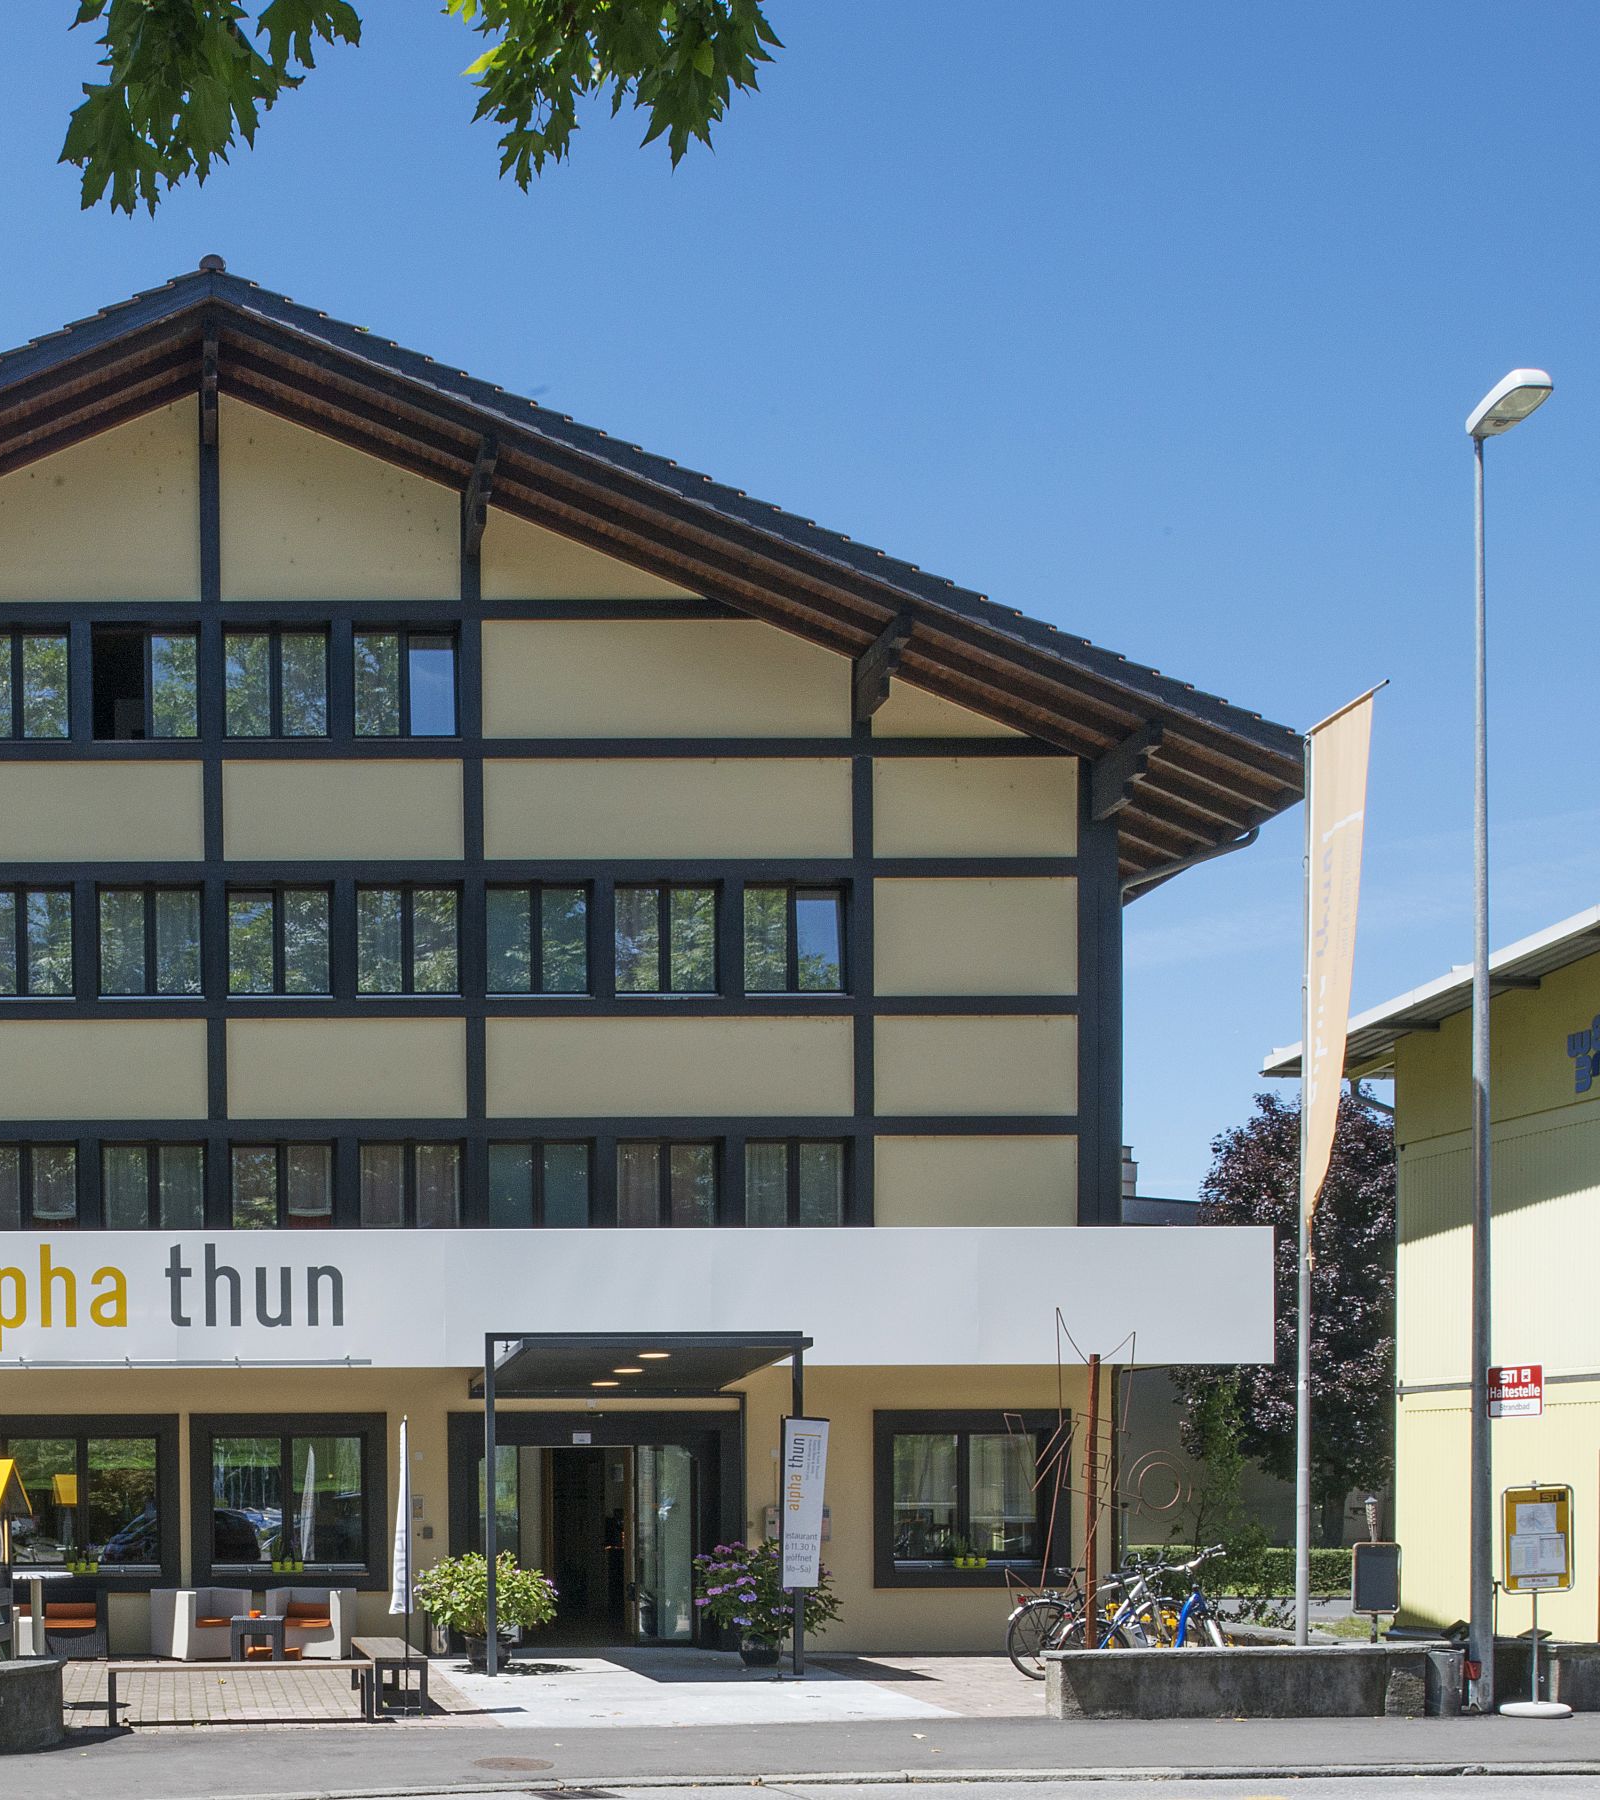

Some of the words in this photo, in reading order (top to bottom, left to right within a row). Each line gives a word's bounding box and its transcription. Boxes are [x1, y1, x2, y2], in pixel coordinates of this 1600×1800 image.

[165, 1243, 344, 1328] thun
[1490, 1383, 1541, 1399] Haltestelle
[787, 1438, 805, 1468] thun
[786, 1474, 805, 1511] alpha
[791, 1543, 809, 1551] 11.30
